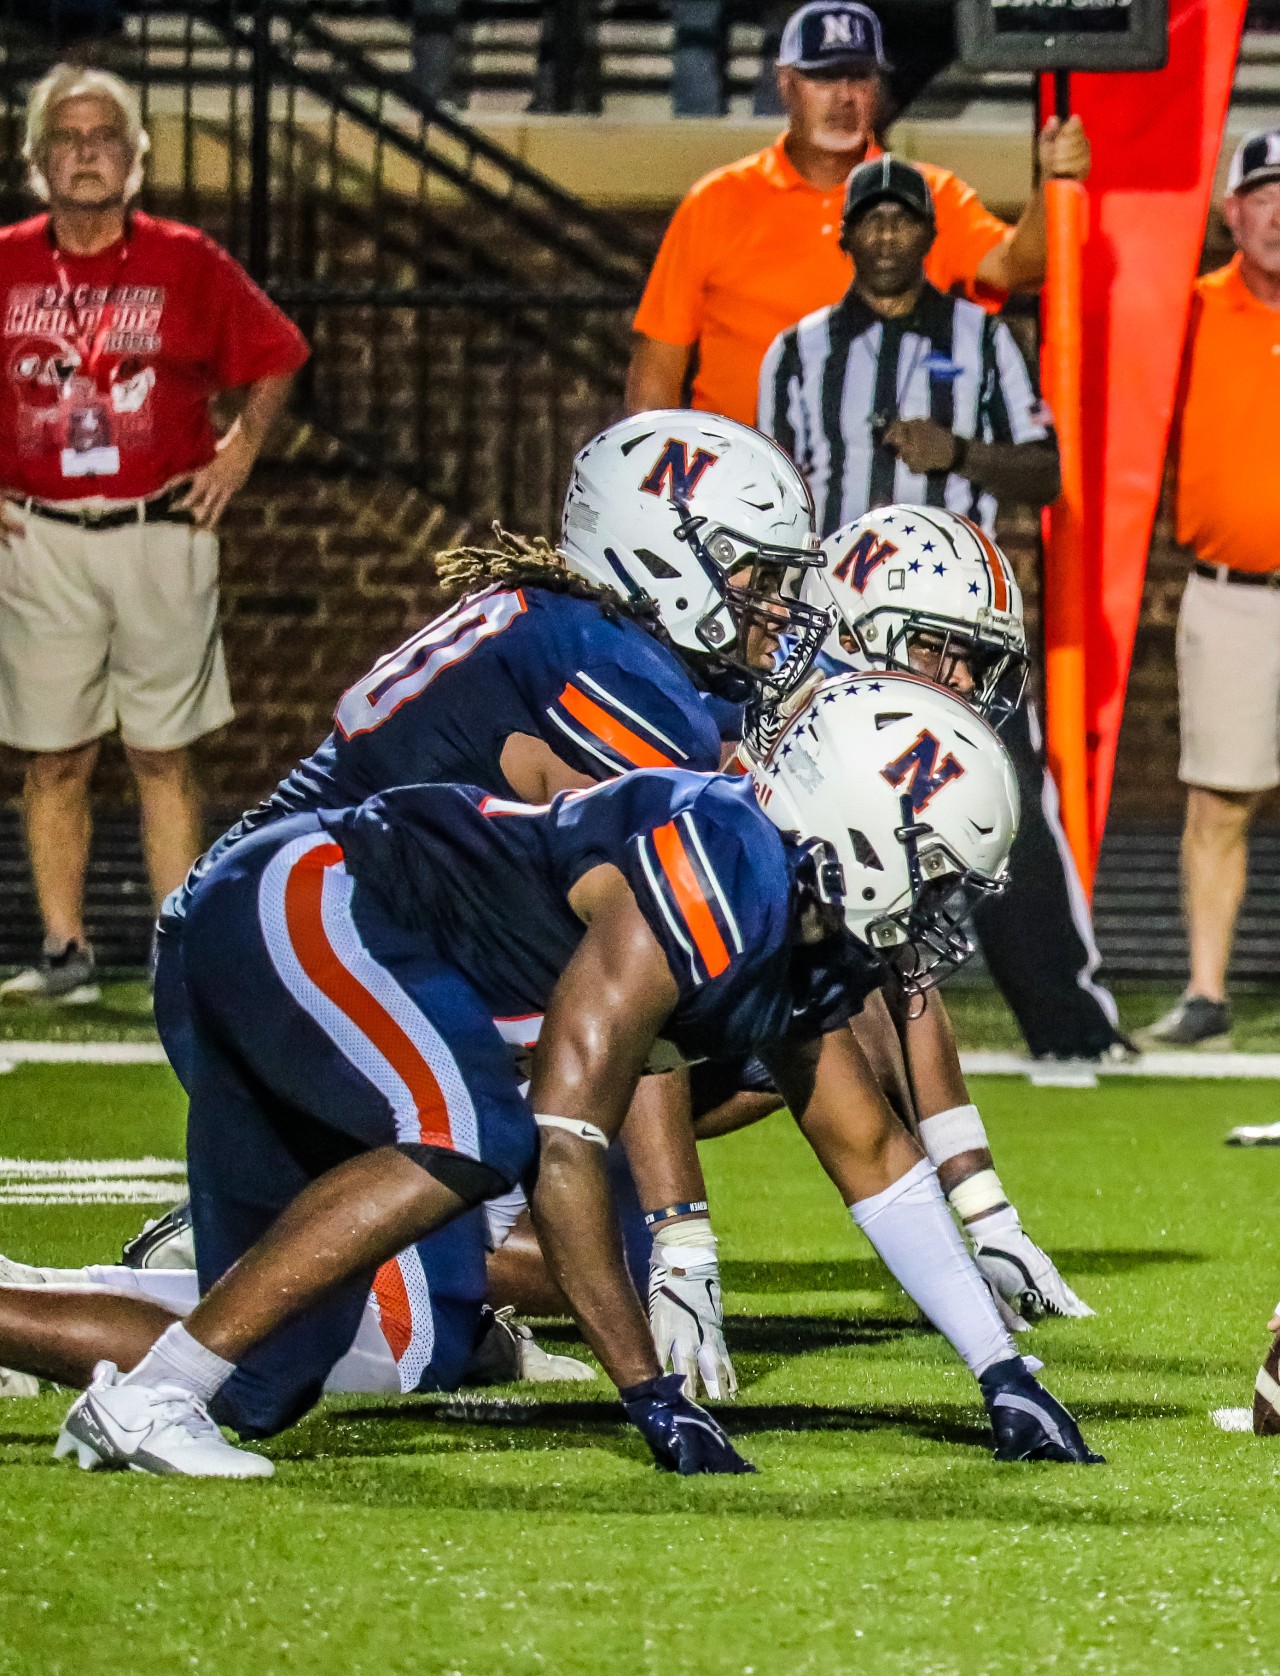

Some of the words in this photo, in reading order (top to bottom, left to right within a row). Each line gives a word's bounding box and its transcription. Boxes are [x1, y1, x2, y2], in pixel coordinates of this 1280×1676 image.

[637, 437, 719, 503] N
[832, 529, 899, 595] N
[879, 728, 965, 814] N
